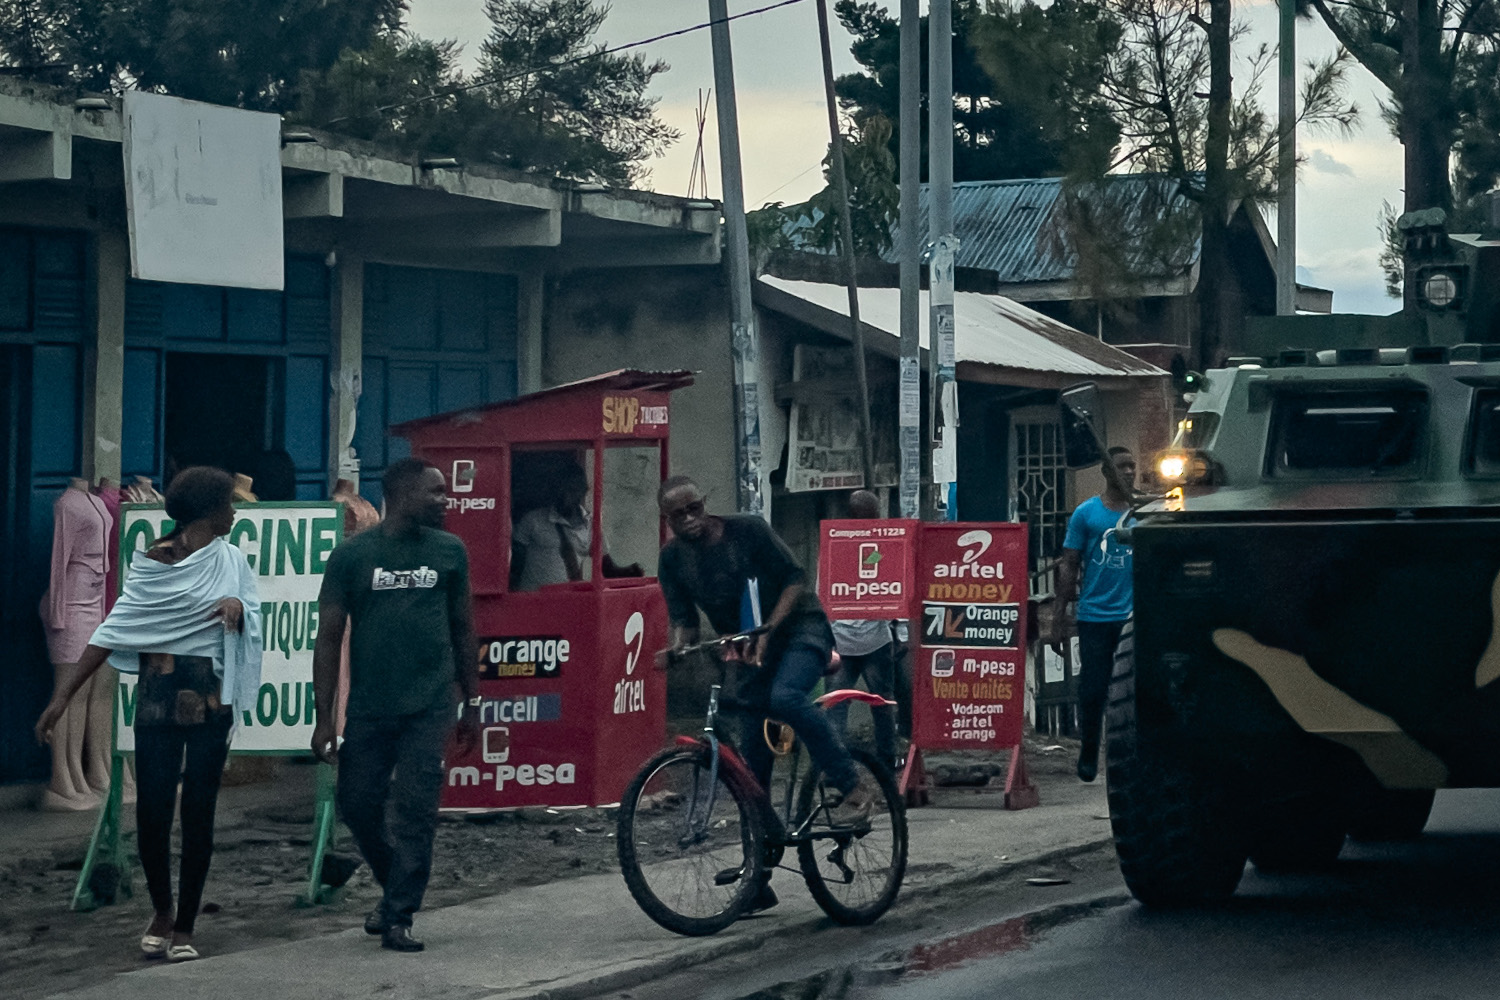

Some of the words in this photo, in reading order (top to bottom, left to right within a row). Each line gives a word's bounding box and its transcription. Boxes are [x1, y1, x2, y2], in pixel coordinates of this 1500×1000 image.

[829, 528, 871, 538] Compose
[933, 561, 1005, 579] airtel
[831, 581, 902, 600] m-pesa
[928, 583, 1013, 604] money
[966, 605, 1019, 625] Orange
[964, 626, 1013, 644] money
[489, 639, 570, 671] orange
[498, 661, 537, 677] money
[963, 658, 1016, 678] m-pesa
[613, 678, 646, 714] airtel
[933, 678, 969, 699] Vente
[951, 703, 1004, 715] Vodacom
[951, 715, 993, 728] airtel
[951, 729, 996, 742] orange
[448, 763, 576, 791] m-pesa
